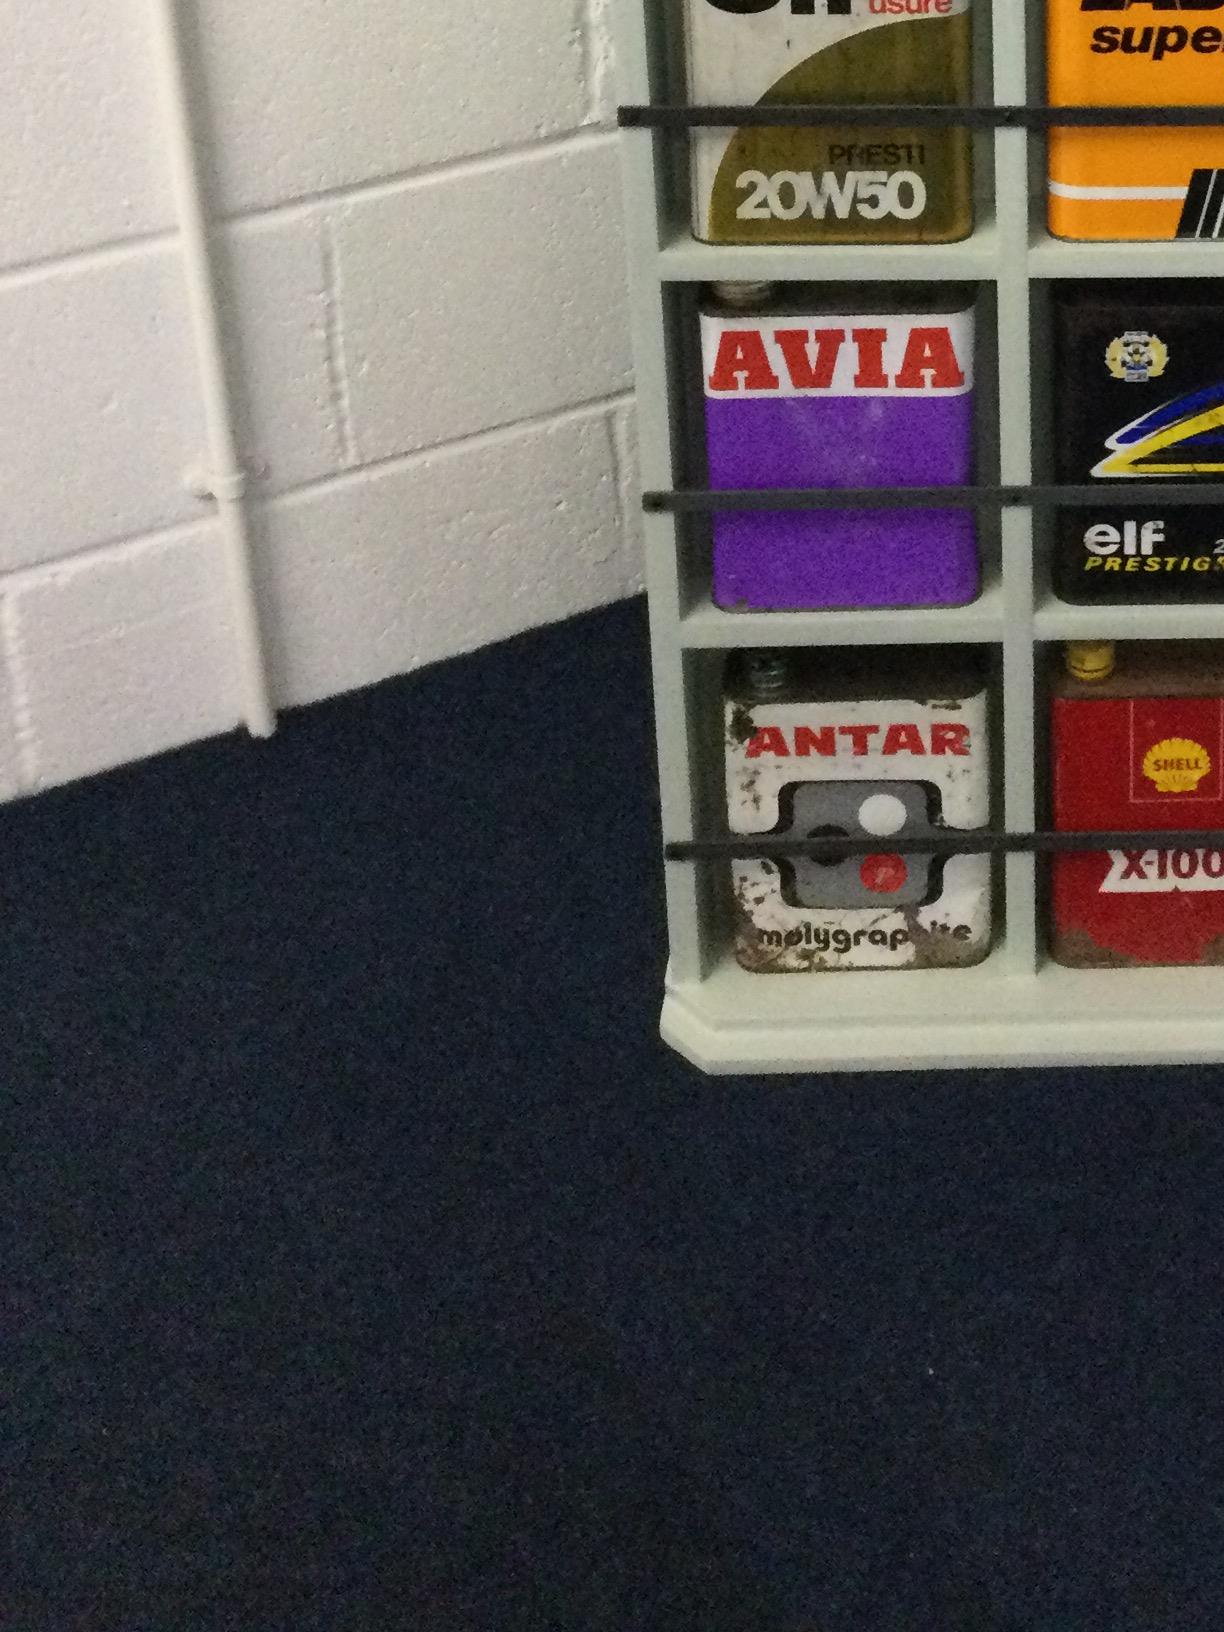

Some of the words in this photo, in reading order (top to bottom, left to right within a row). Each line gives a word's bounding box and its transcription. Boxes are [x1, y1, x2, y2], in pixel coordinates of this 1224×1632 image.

[736, 170, 928, 220] 20W50
[708, 327, 965, 391] AVIA
[1083, 519, 1167, 556] elf
[744, 722, 972, 760] ANTAR
[1152, 756, 1203, 772] SHELL
[756, 919, 973, 954] molygrapite
